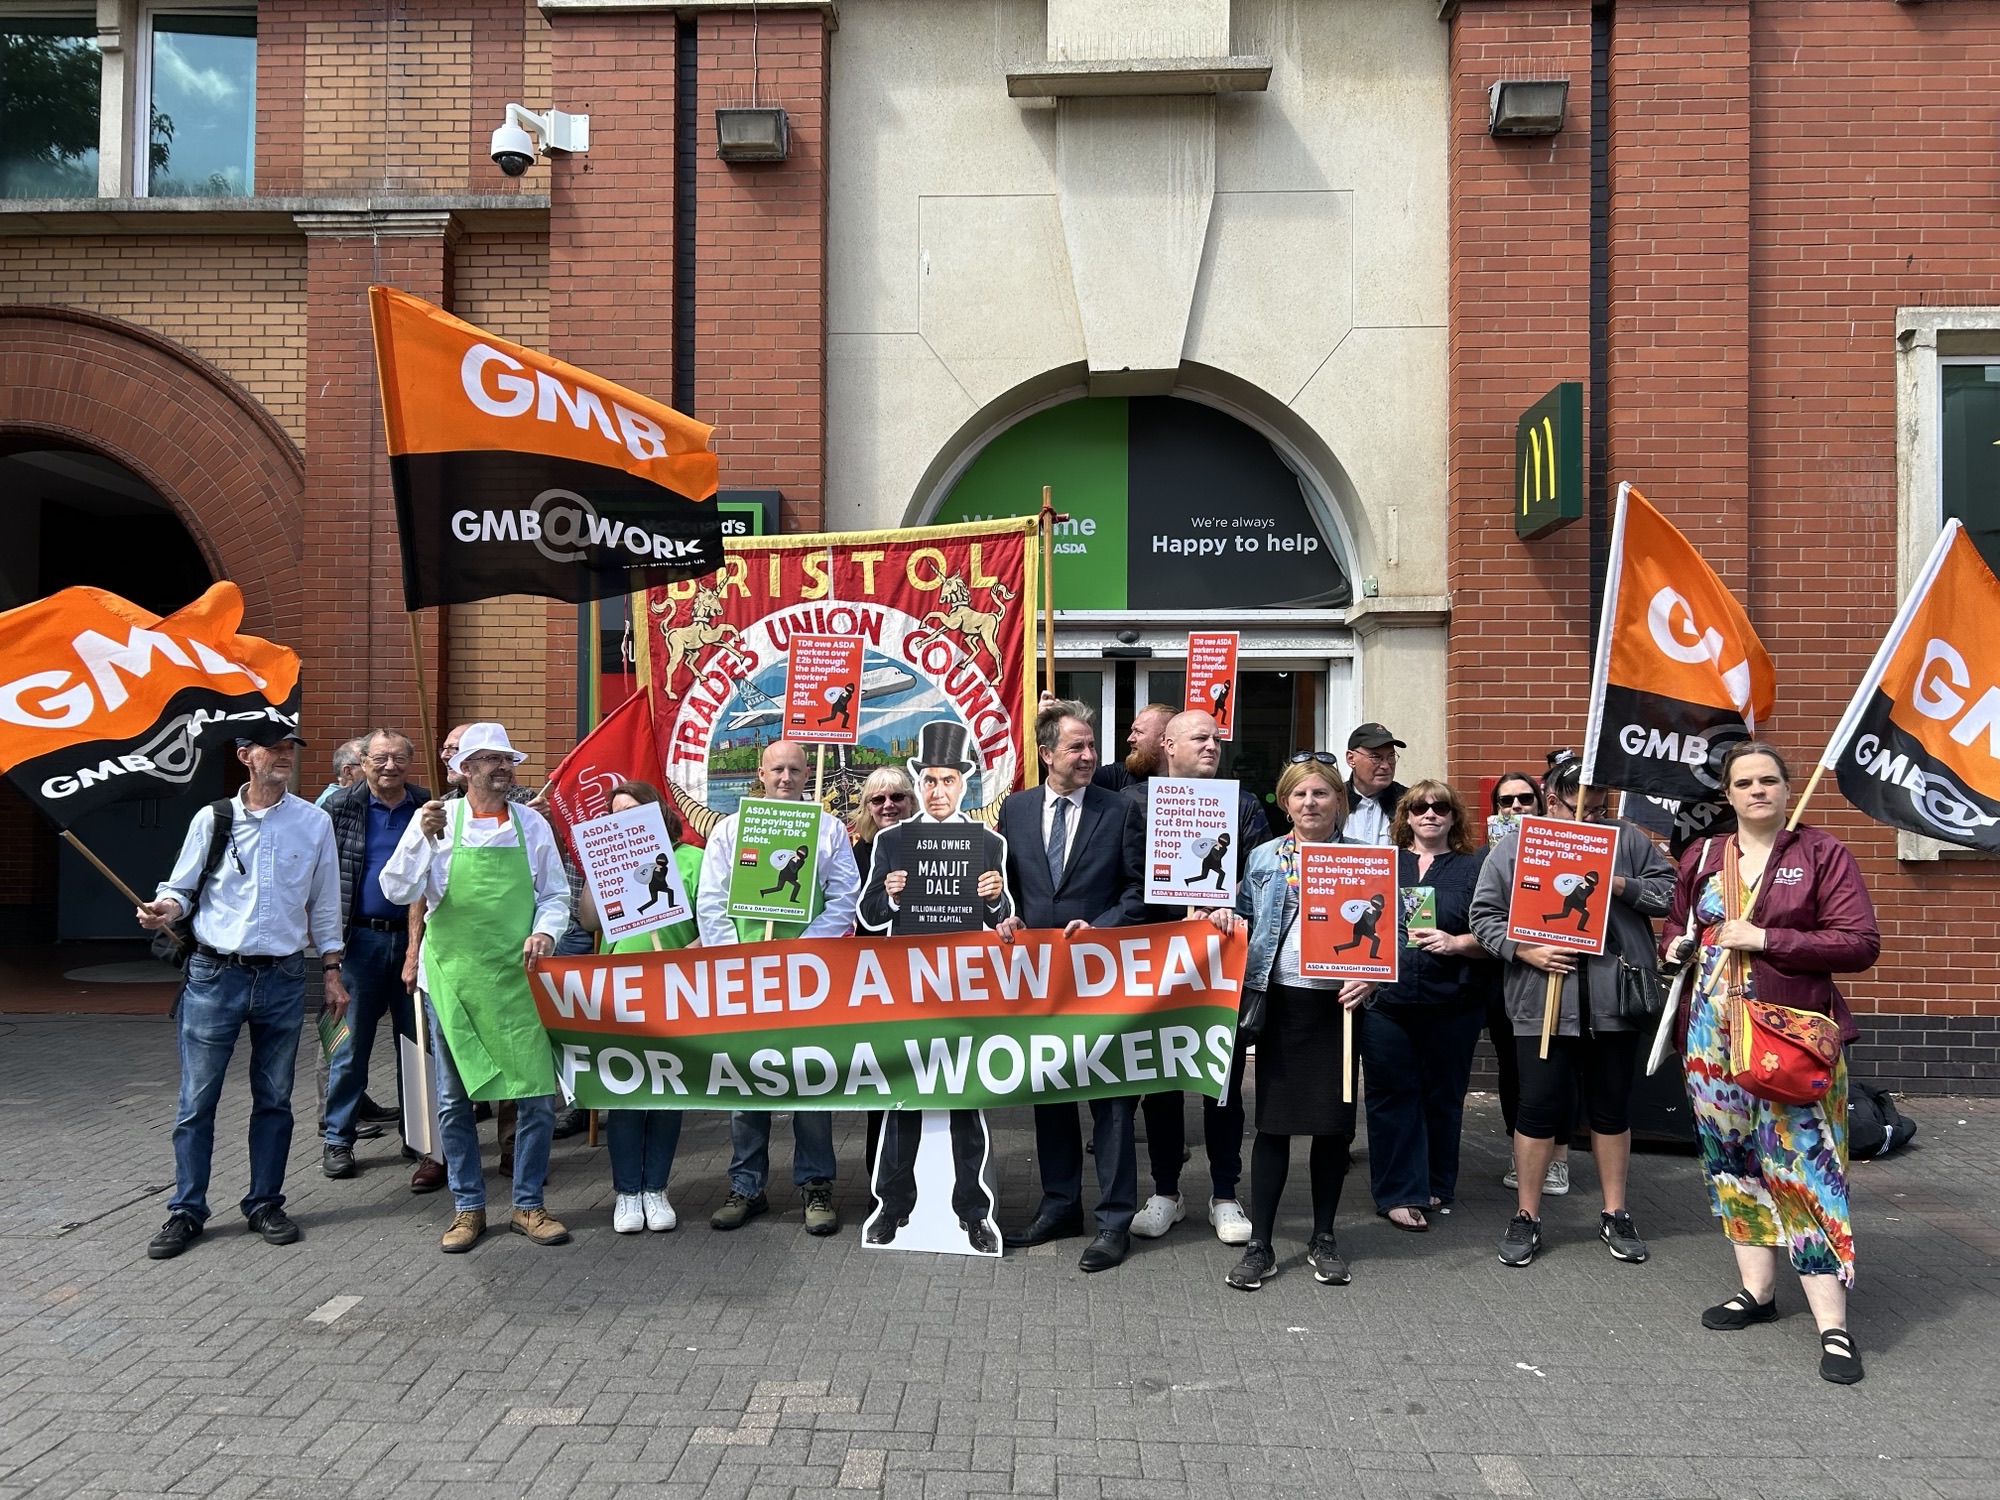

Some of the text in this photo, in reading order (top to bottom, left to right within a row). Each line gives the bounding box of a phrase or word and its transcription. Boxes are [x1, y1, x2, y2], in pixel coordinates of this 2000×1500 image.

[460, 343, 668, 460] GMB
[452, 489, 703, 562] GMB@WORK
[1191, 517, 1275, 529] We're always
[1053, 543, 1087, 554] ASDA
[1152, 533, 1319, 556] Happy to help
[765, 607, 885, 652] UNION
[797, 639, 813, 647] TDR
[833, 641, 855, 649] ASDA
[1216, 638, 1232, 646] ASDA
[812, 657, 846, 667] through
[811, 665, 850, 675] shopfloor
[793, 682, 818, 690] equal
[793, 691, 810, 700] pay
[903, 630, 1010, 771] COUNCIL
[672, 642, 760, 765] TRADES
[792, 698, 819, 707] claim.
[1156, 785, 1194, 795] ASDA's
[1156, 798, 1219, 807] owners TDR
[746, 806, 816, 819] ASDA's workers
[1155, 807, 1225, 818] Capital have
[761, 818, 793, 828] paying
[795, 819, 811, 828] the
[1155, 818, 1227, 829] cut 8m hours
[582, 822, 619, 839] ASDA's
[743, 826, 807, 838] price for TDR's
[1154, 828, 1201, 838] from the
[1527, 826, 1608, 844] ASDA colleagues
[585, 824, 646, 849] owners TDR
[742, 835, 771, 845] debts.
[588, 834, 656, 859] Capital have
[916, 839, 971, 850] ASDA OWNER
[1154, 839, 1182, 851] shop
[1525, 837, 1608, 854] are being robbed
[591, 843, 661, 869] cut 8m hours
[1154, 849, 1182, 860] floor.
[1307, 854, 1389, 866] ASDA colleagues
[1535, 849, 1555, 858] pay
[1556, 850, 1582, 861] TDR's
[1523, 856, 1551, 867] debts
[594, 860, 640, 879] from the
[918, 860, 970, 877] MANJIT
[1155, 868, 1170, 876] GMB
[1325, 865, 1353, 876] being
[1354, 867, 1390, 876] robbed
[597, 876, 624, 889] shop
[1307, 876, 1366, 887] to pay TDR's
[1524, 875, 1540, 883] GMB
[600, 886, 628, 899] floor.
[926, 879, 960, 895] DALE
[1307, 886, 1335, 895] debts
[911, 905, 973, 914] BILLIONAIRE PARTNER
[1310, 906, 1326, 914] GMB
[926, 915, 938, 923] TDR
[1538, 932, 1567, 940] DAYLIGHT
[538, 934, 1238, 1023] WE NEED A NEW DEAL
[561, 1024, 1234, 1097] FOR ASDA WORKERS
